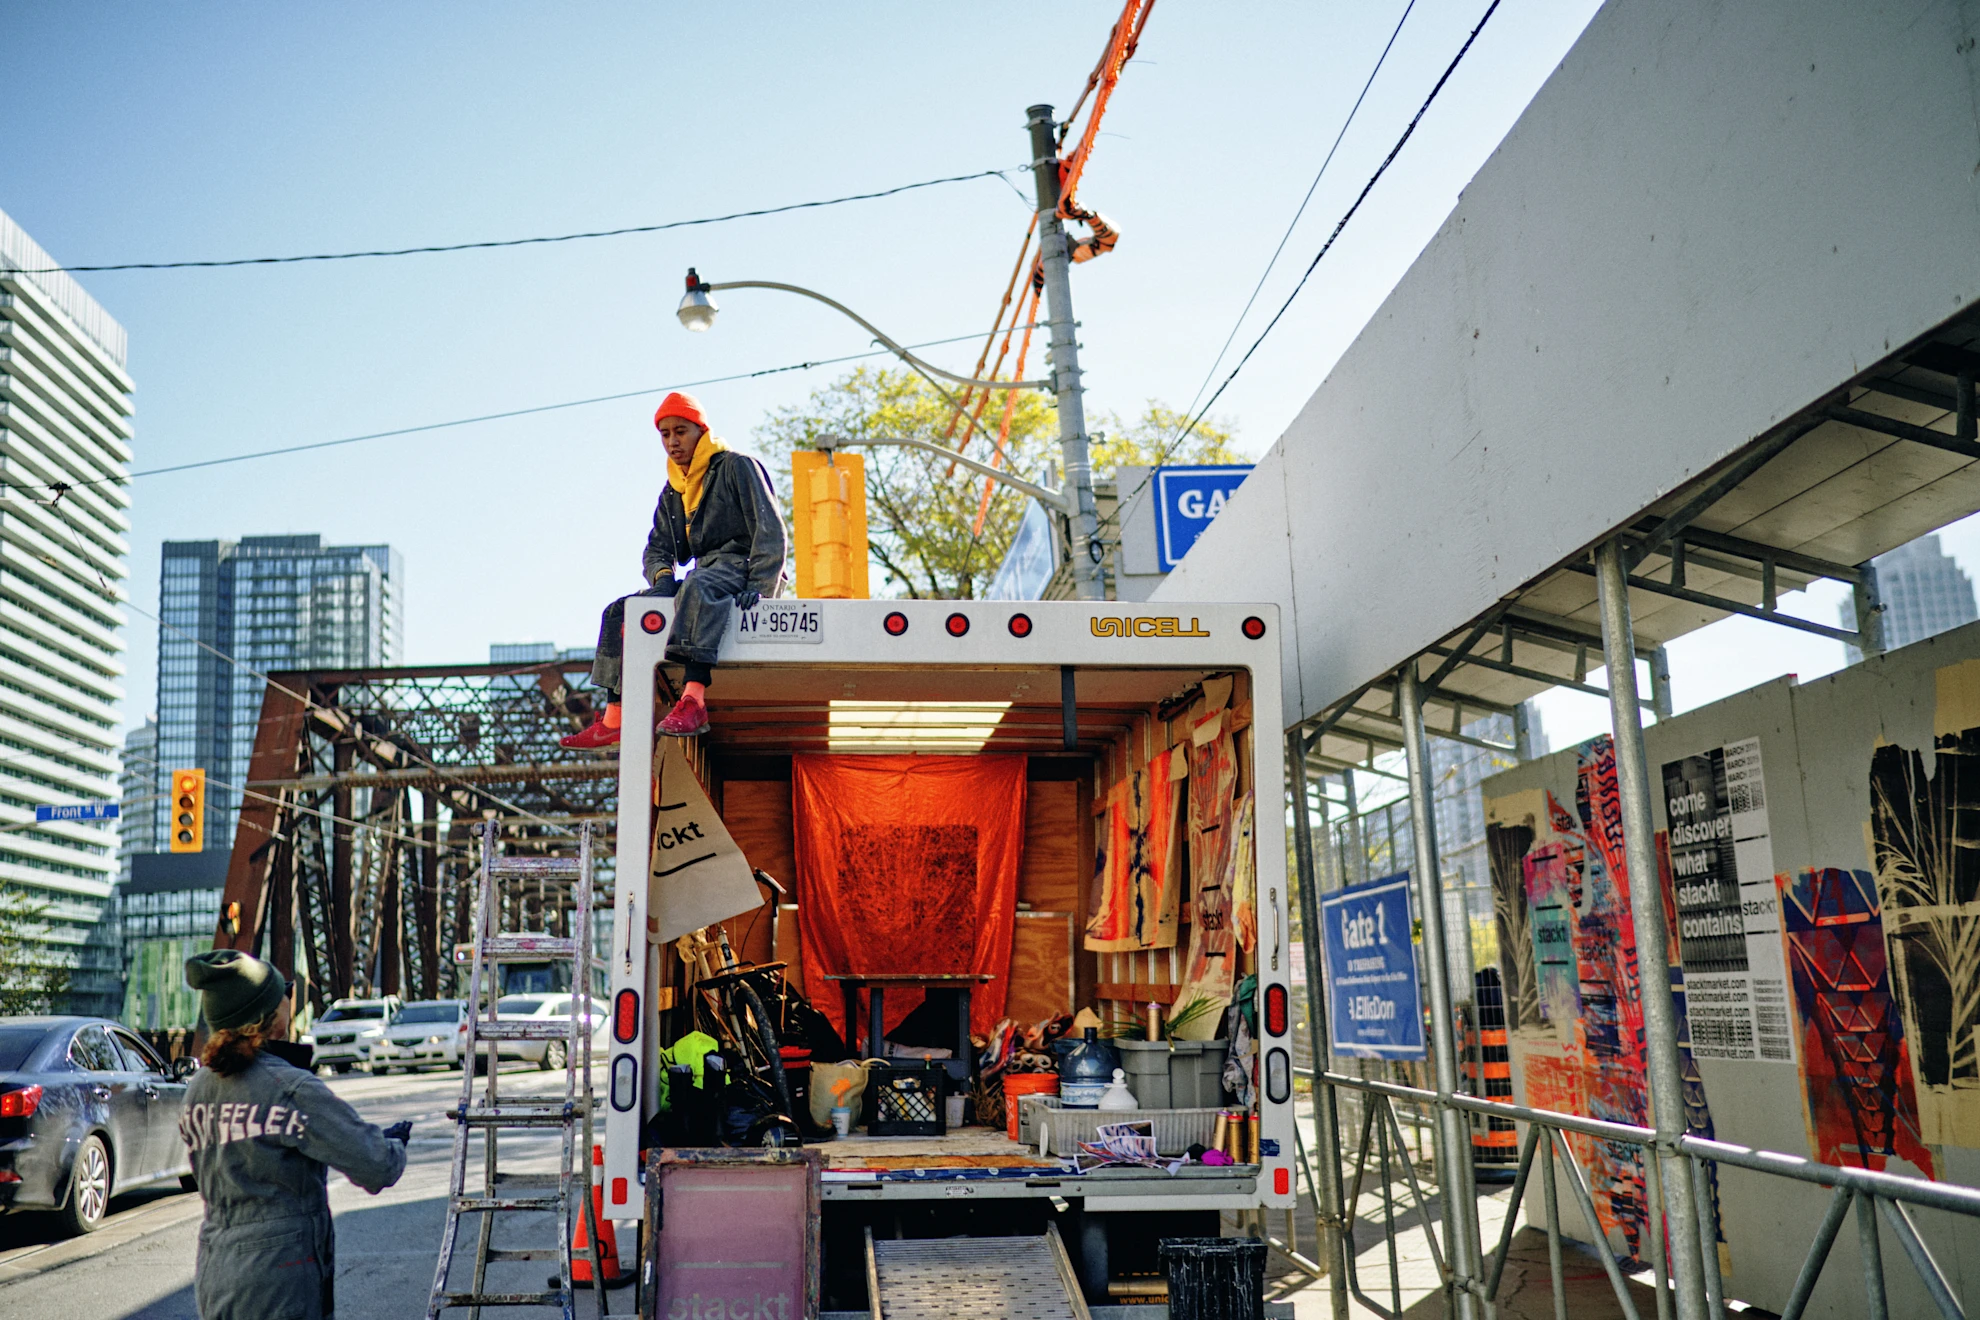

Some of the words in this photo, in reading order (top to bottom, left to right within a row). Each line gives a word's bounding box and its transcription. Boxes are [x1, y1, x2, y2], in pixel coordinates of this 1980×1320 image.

[740, 612, 759, 632] AV
[770, 612, 818, 632] 96745
[1090, 617, 1210, 637] UNICELL
[51, 806, 81, 819] Front
[94, 804, 105, 817] W
[1669, 791, 1707, 817] come
[1672, 816, 1731, 847] discover
[1675, 850, 1709, 876] what
[1679, 878, 1721, 907] stackt
[1742, 897, 1777, 916] stackt
[1375, 901, 1388, 945] 1
[1537, 923, 1567, 944] stackt
[1683, 909, 1744, 939] contains
[1686, 978, 1747, 990] stacktmarket.com
[1687, 990, 1749, 1002] stacktmarket.com
[1355, 995, 1395, 1020] EllisDon
[1689, 1004, 1750, 1018] stacktmarket.com
[1693, 1046, 1756, 1060] stacktmarket.com
[667, 1292, 790, 1320] stackt
